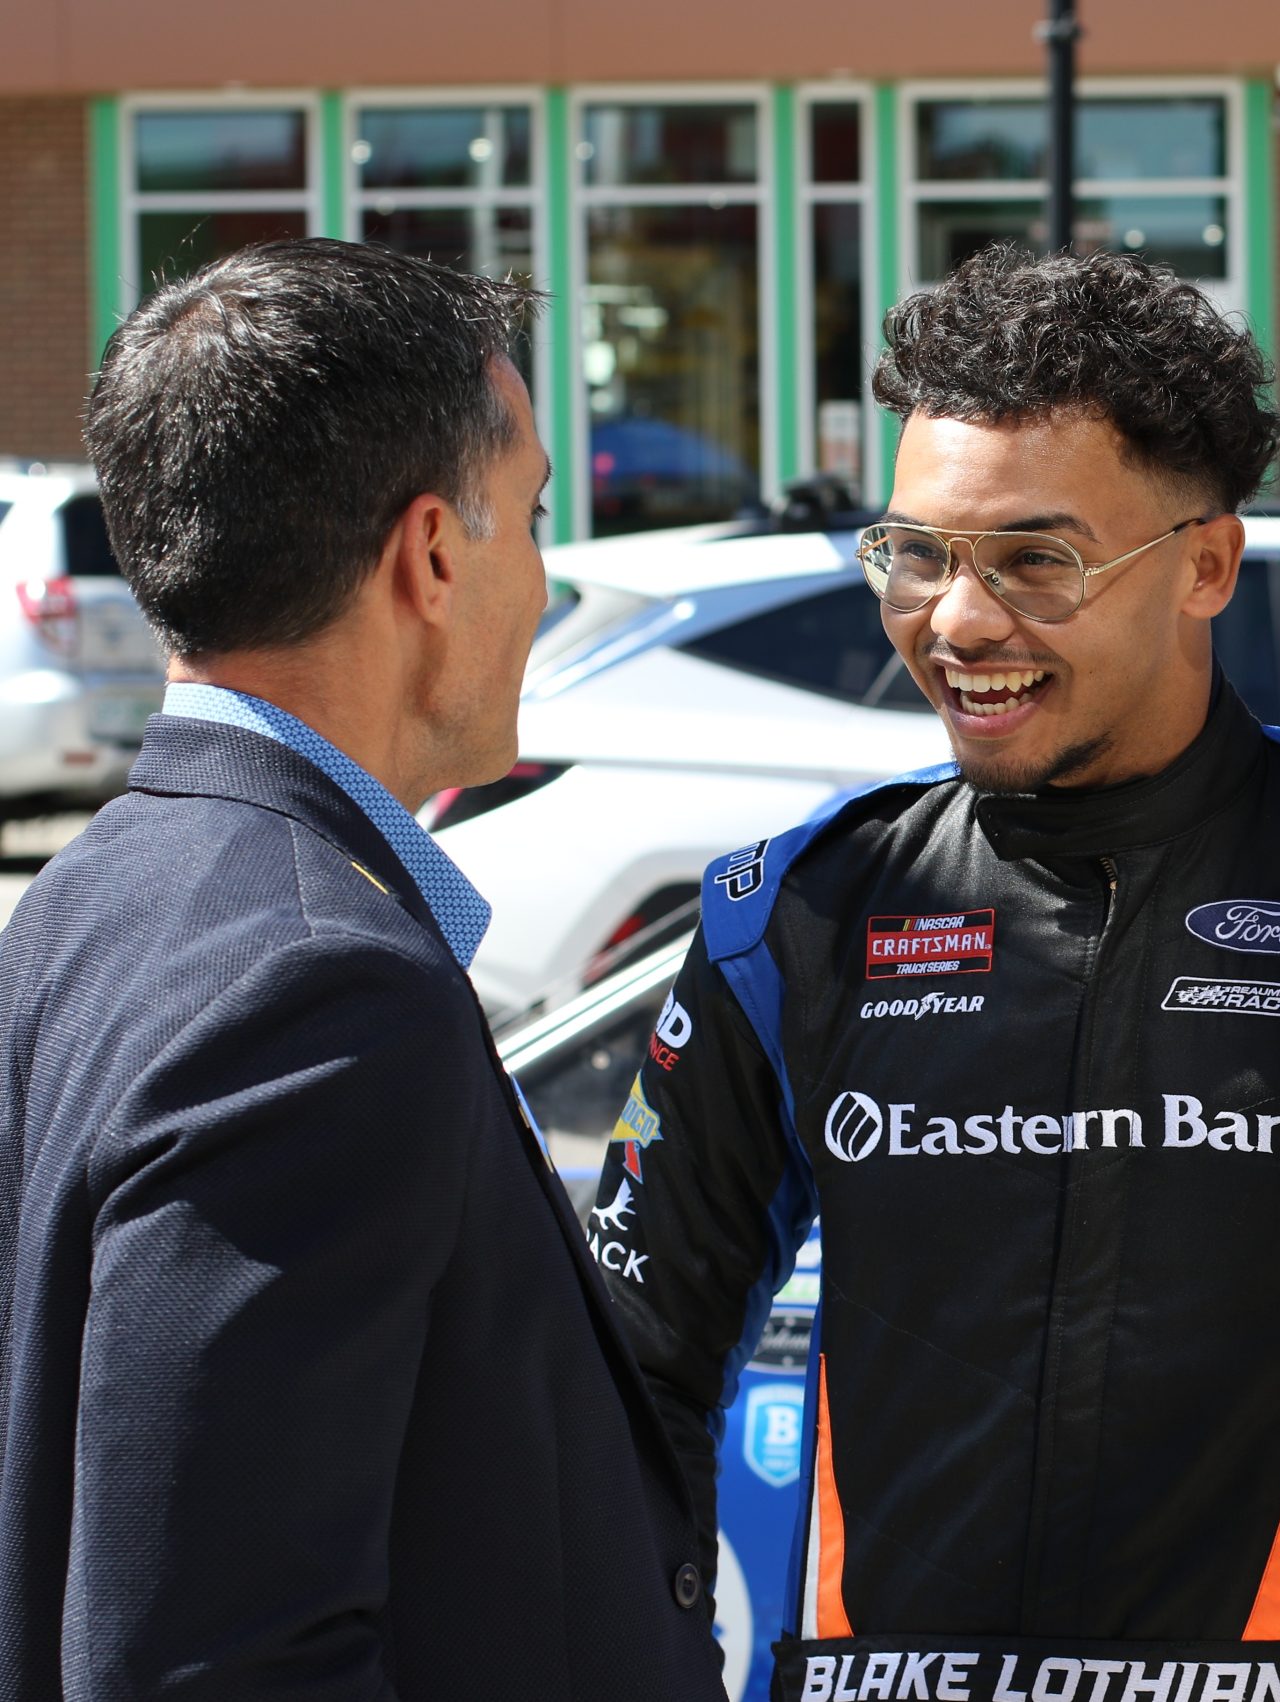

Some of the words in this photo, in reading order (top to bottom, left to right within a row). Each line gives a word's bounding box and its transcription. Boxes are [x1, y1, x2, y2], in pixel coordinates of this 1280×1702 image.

[918, 915, 966, 931] NASCAR
[872, 931, 986, 957] CRAFTSMAN
[896, 962, 928, 975] TRUCK
[926, 960, 960, 973] SERIES
[860, 992, 985, 1020] GOODYEAR
[888, 1102, 1147, 1156] Eastern
[800, 1652, 979, 1702] BLAKE
